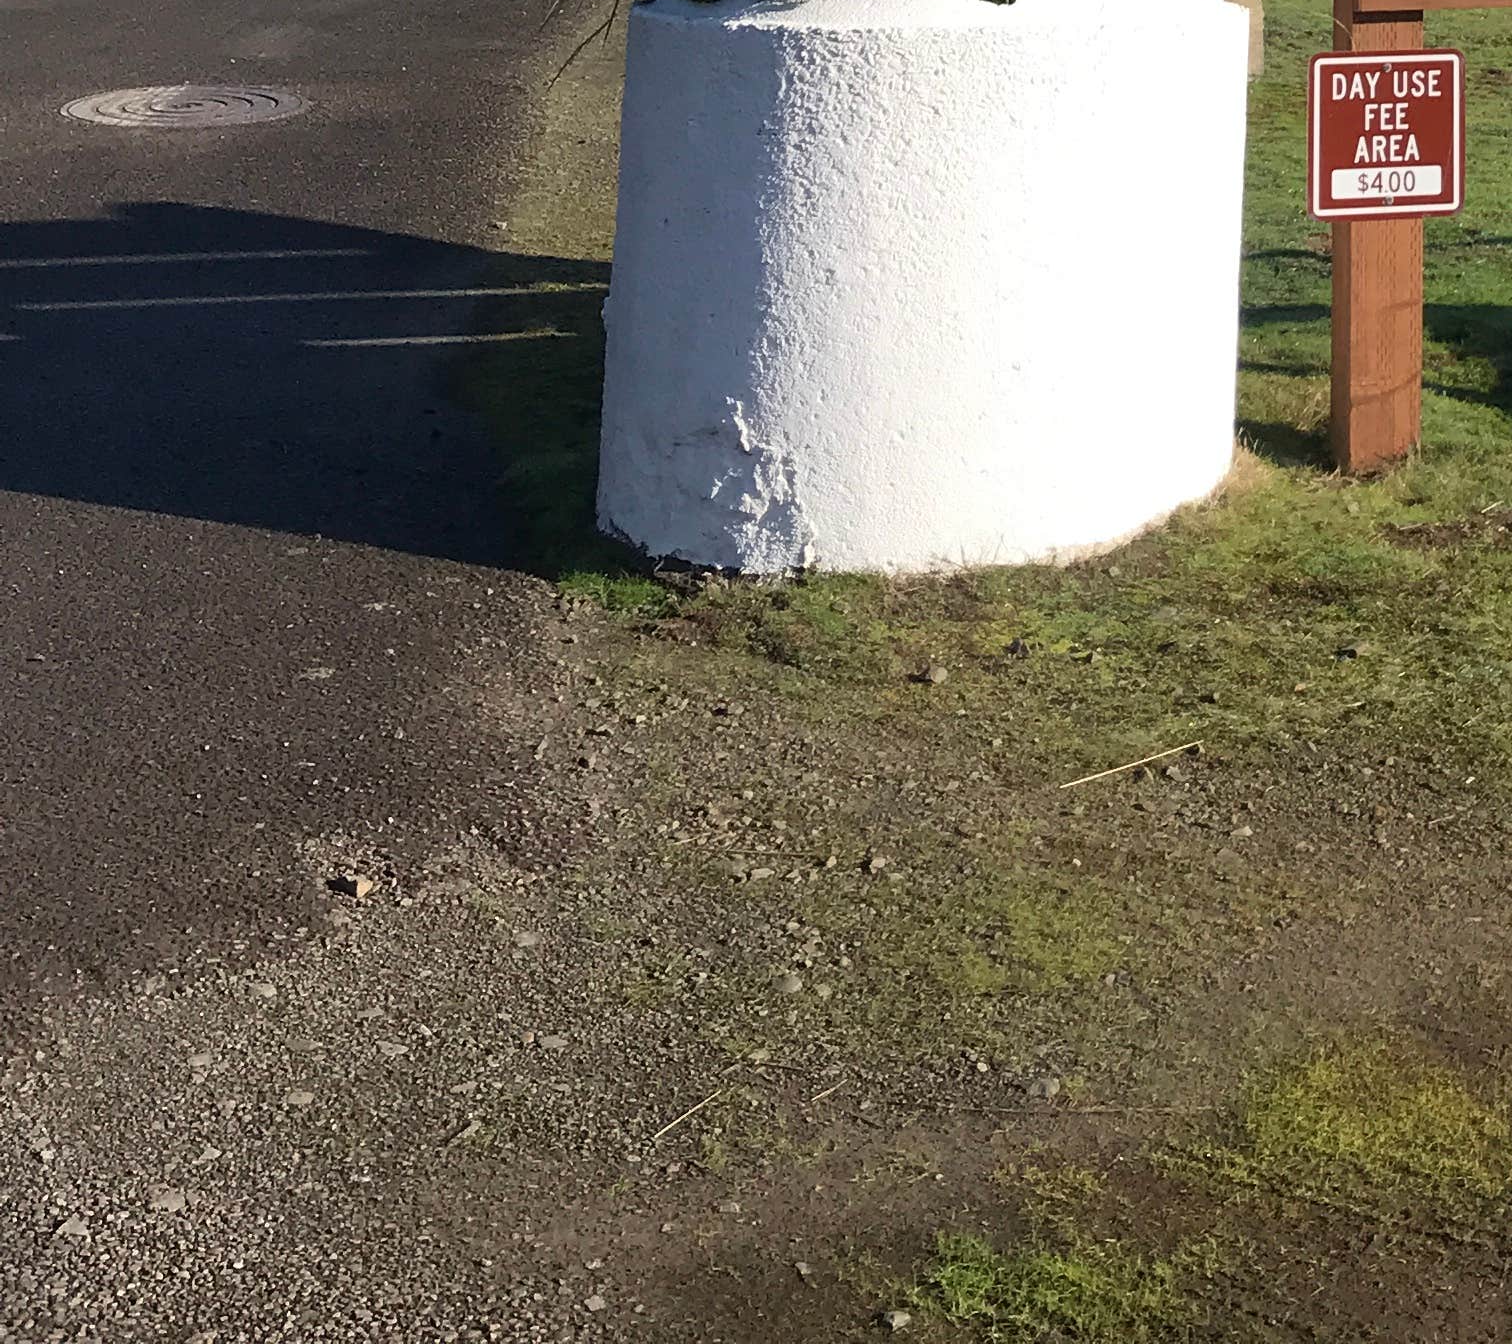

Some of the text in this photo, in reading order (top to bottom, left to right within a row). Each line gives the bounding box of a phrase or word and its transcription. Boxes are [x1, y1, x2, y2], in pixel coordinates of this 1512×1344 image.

[1332, 70, 1441, 100] DAY USE
[1364, 102, 1409, 131] FEE
[1354, 134, 1420, 164] AREA
[1357, 170, 1416, 194] $4.00
